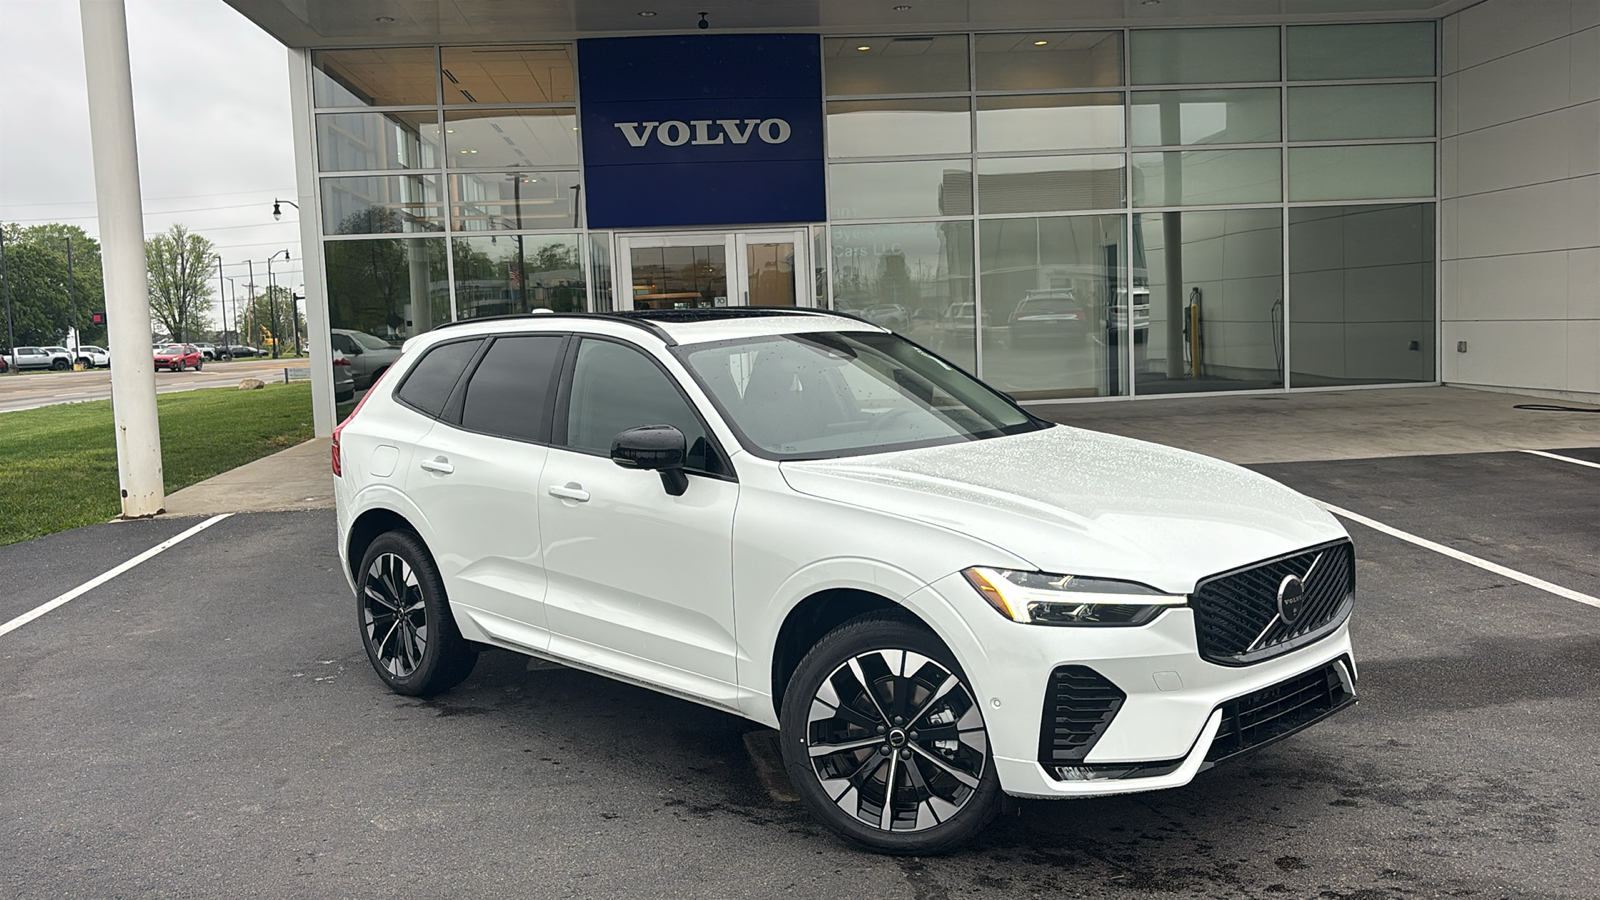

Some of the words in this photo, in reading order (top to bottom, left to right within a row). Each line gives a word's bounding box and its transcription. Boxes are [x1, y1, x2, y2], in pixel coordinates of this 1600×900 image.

[614, 118, 792, 147] VOLVO
[833, 244, 868, 258] Cars
[873, 242, 902, 256] LLC
